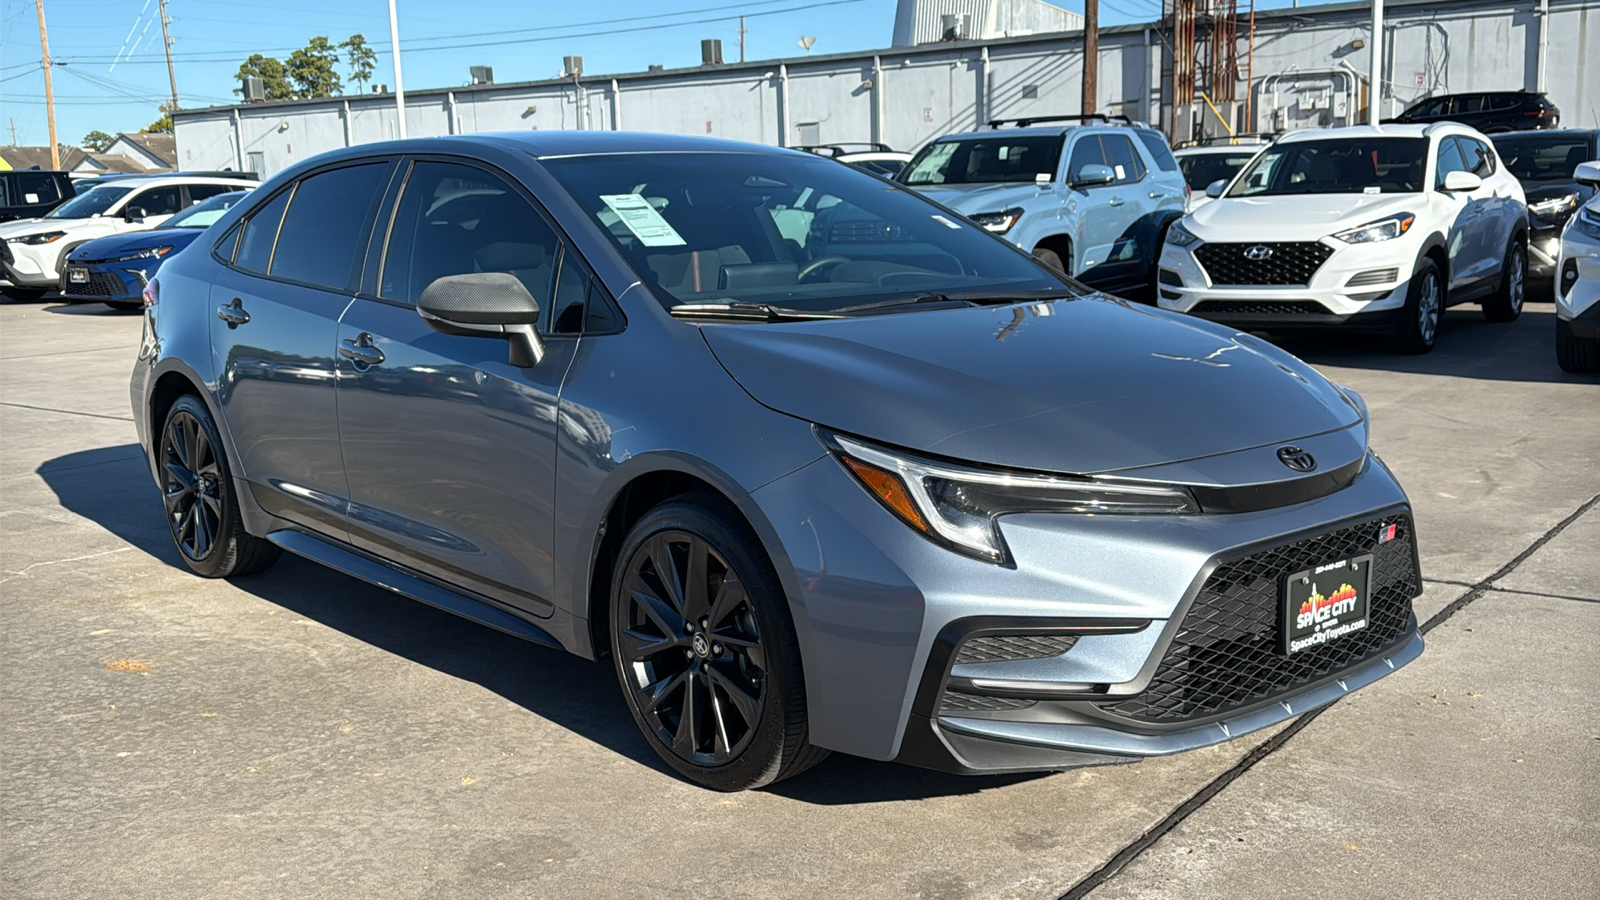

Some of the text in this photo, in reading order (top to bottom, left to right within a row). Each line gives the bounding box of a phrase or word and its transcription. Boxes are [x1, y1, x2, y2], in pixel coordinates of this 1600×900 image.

[1297, 596, 1357, 629] SPACE CITY
[1290, 619, 1366, 652] SpaceCityToyota.com
